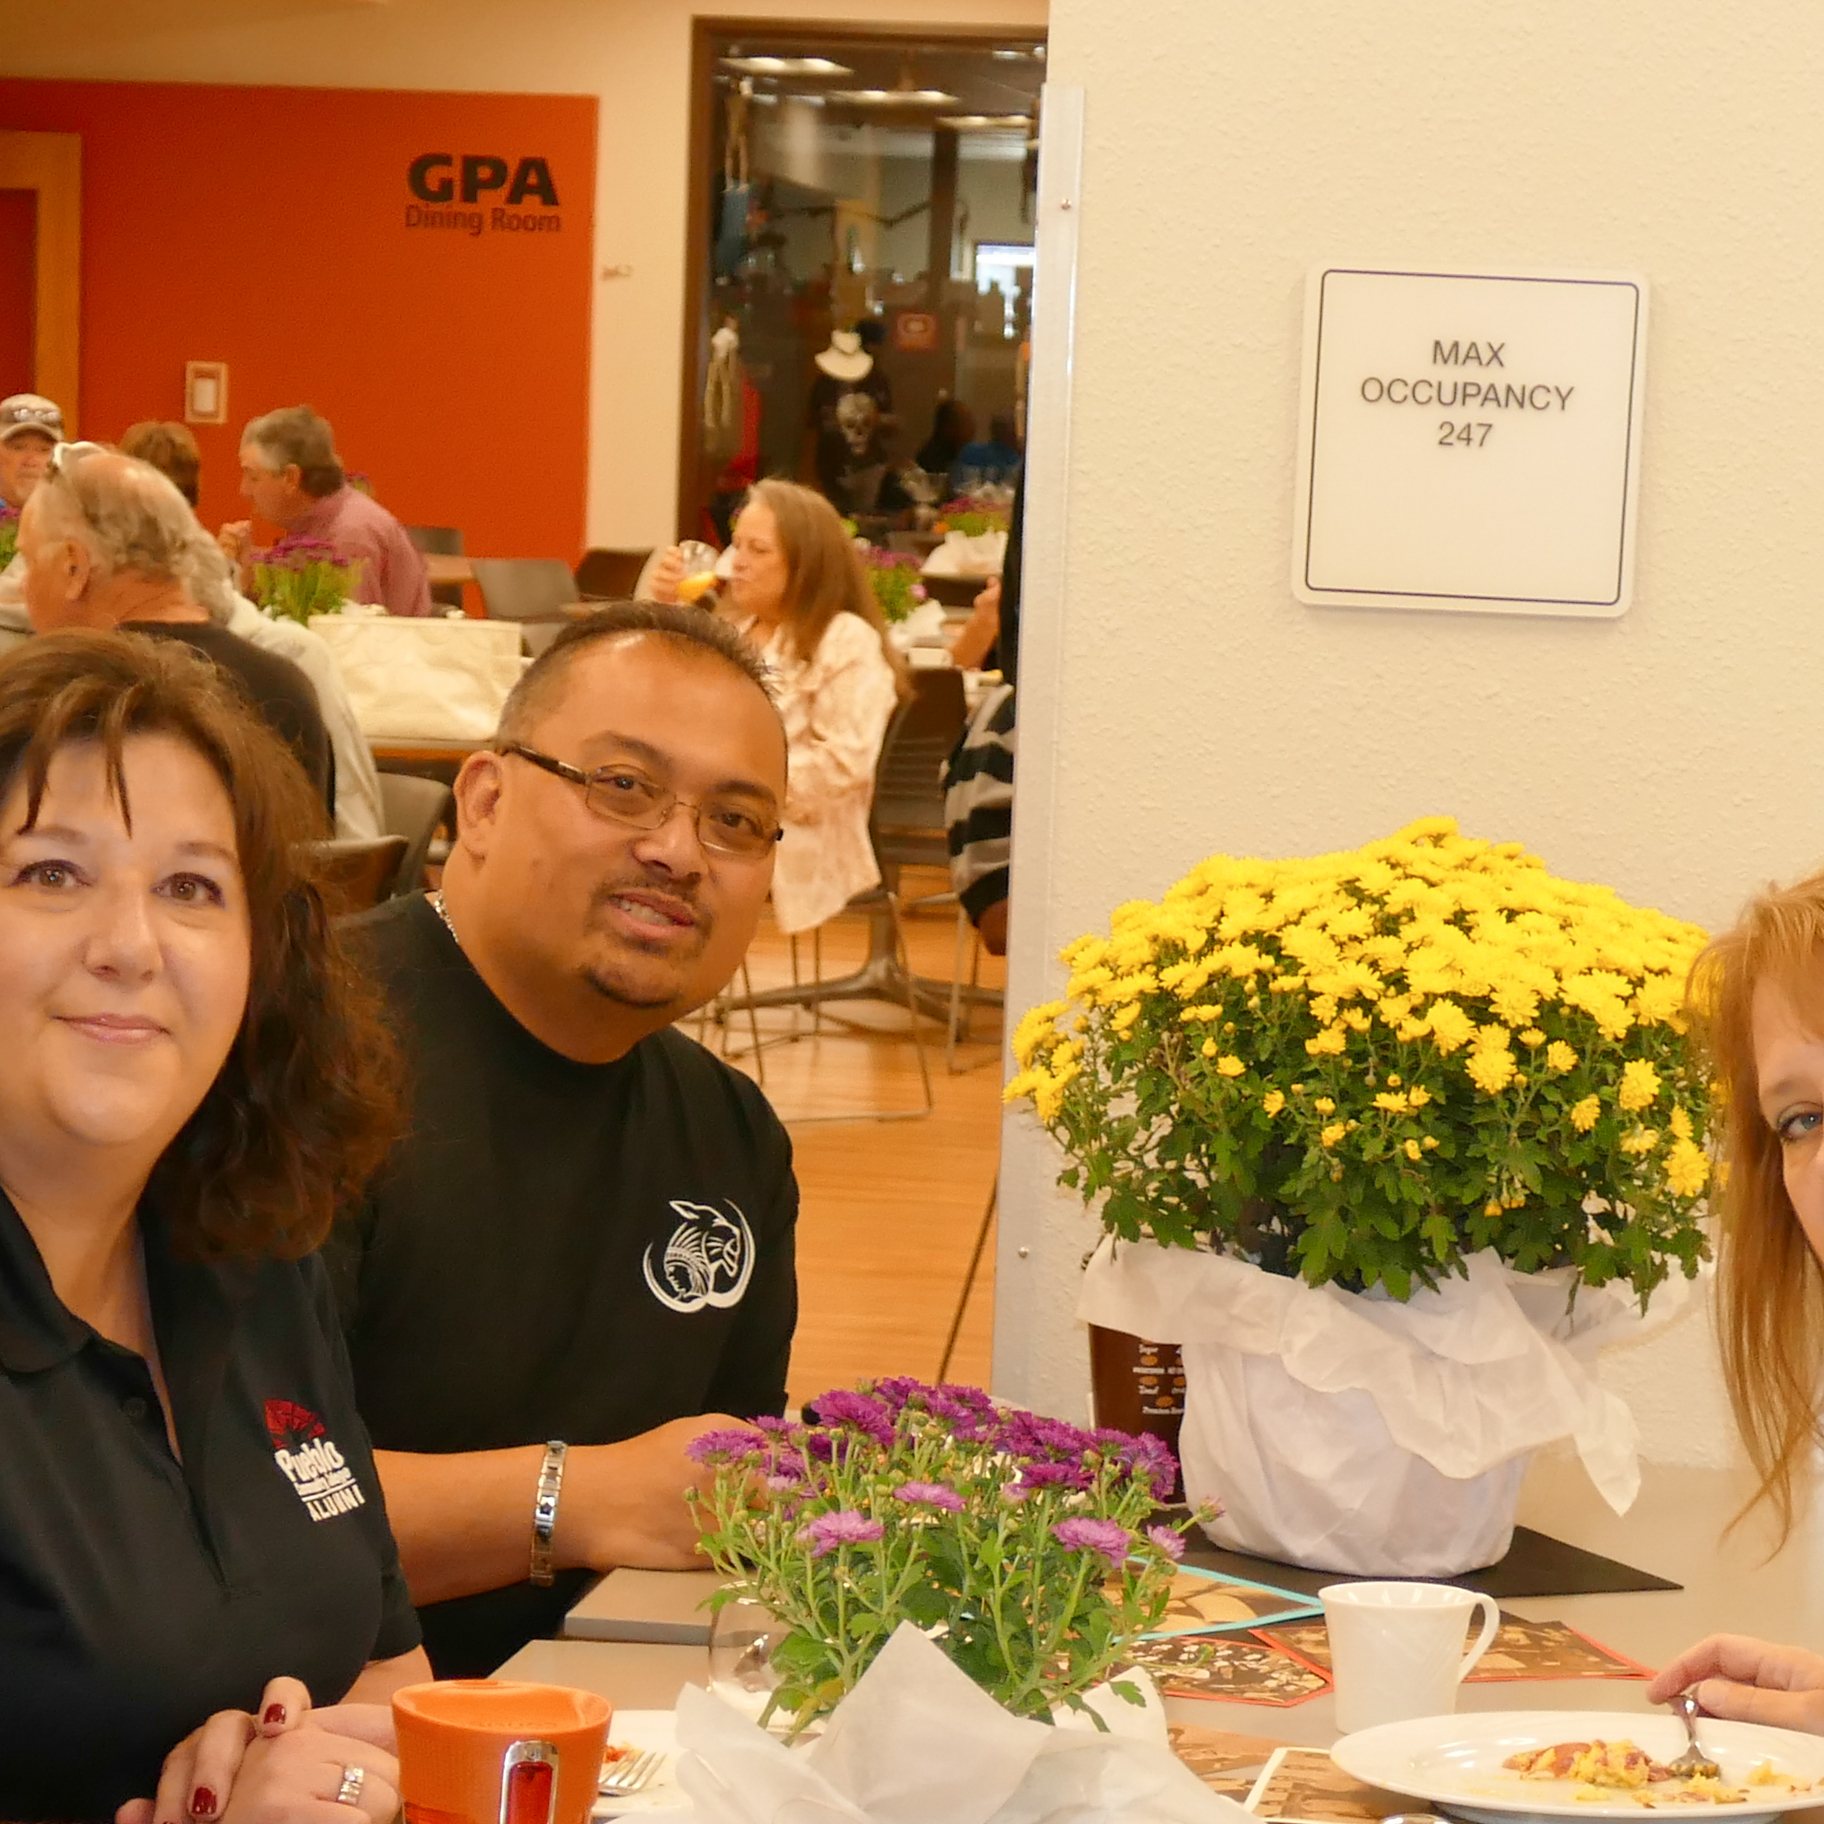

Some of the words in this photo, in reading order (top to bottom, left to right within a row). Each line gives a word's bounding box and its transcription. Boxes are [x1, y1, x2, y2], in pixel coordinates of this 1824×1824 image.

[408, 153, 560, 207] GPA
[405, 203, 484, 237] Dining
[491, 207, 562, 232] Room
[1432, 339, 1506, 367] MAX
[1360, 376, 1575, 411] OCCUPANCY
[1438, 421, 1493, 447] 247
[306, 1483, 366, 1521] ALUMNI
